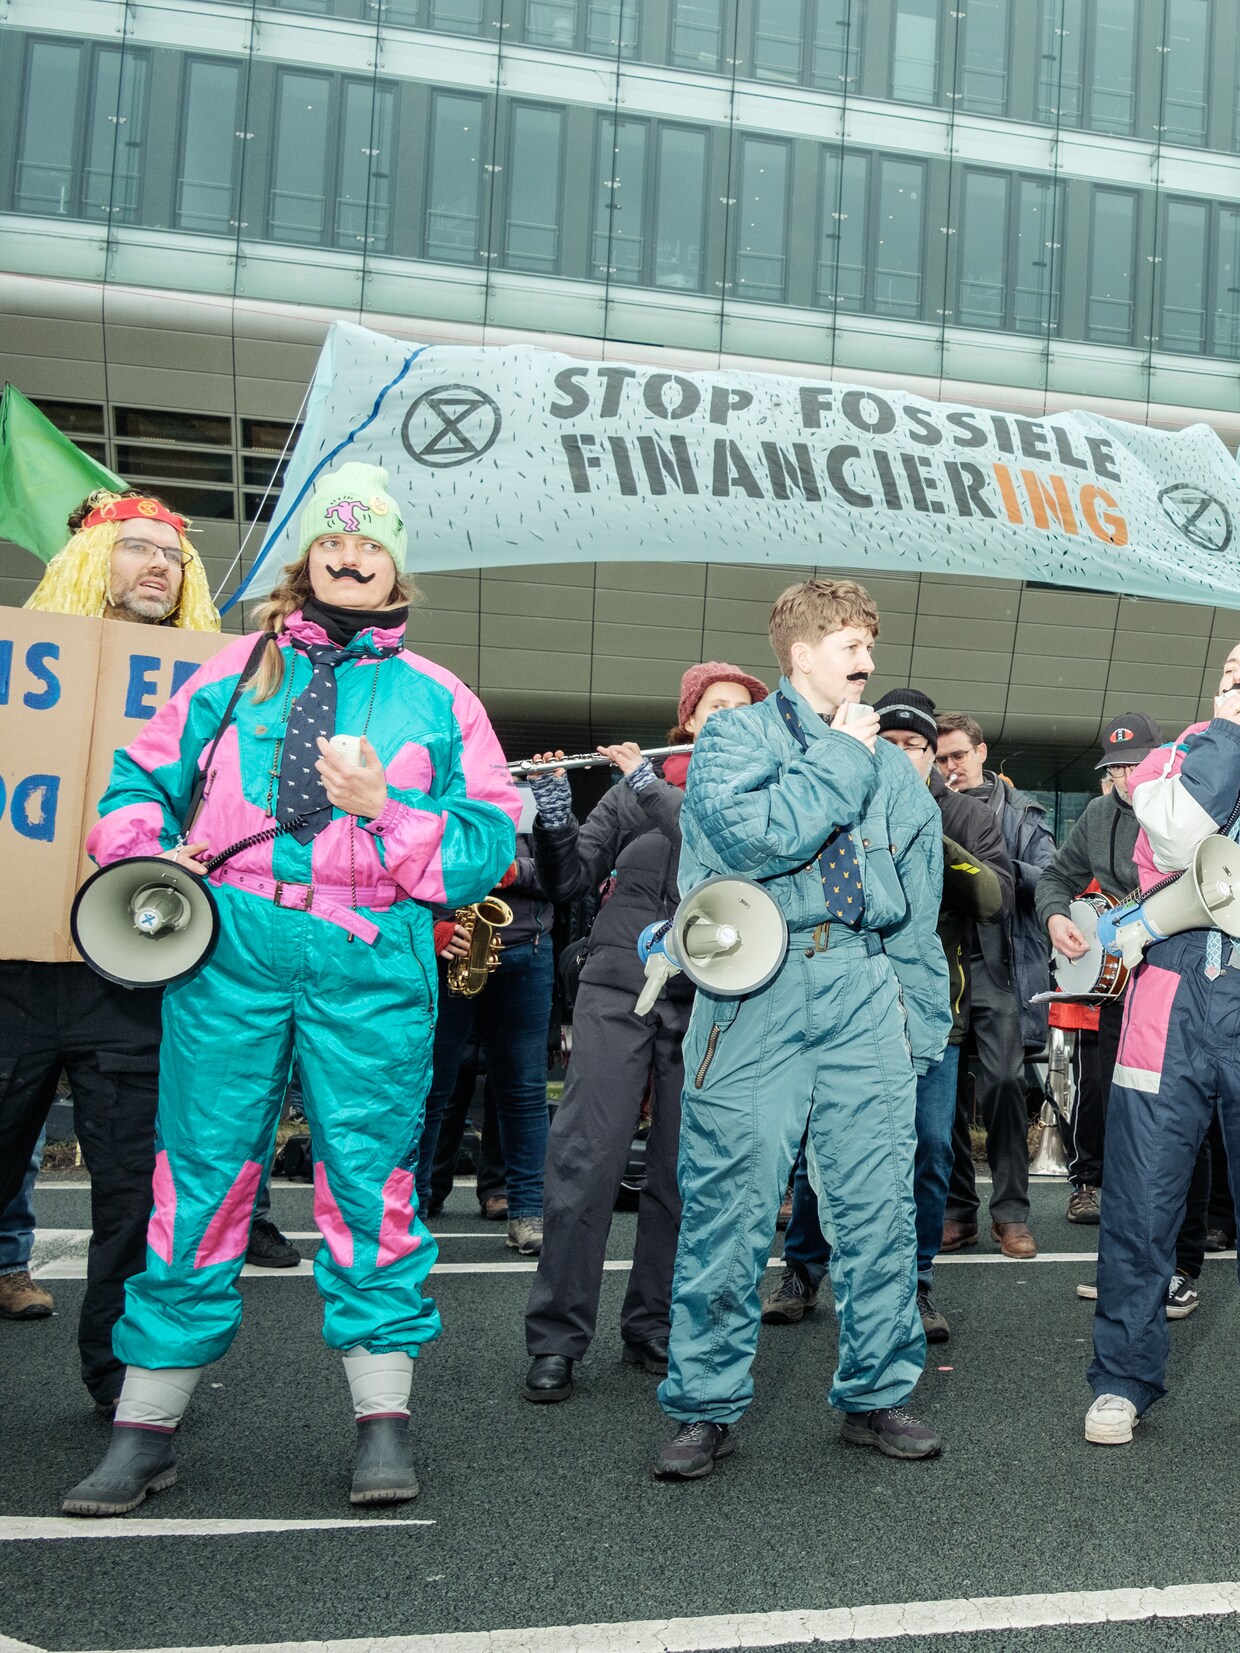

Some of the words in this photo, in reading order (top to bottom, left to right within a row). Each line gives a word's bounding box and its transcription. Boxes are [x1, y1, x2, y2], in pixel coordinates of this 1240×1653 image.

[549, 366, 753, 426] STOP
[800, 386, 1122, 483] FOSSIELE
[560, 433, 1129, 547] FINANCIERING
